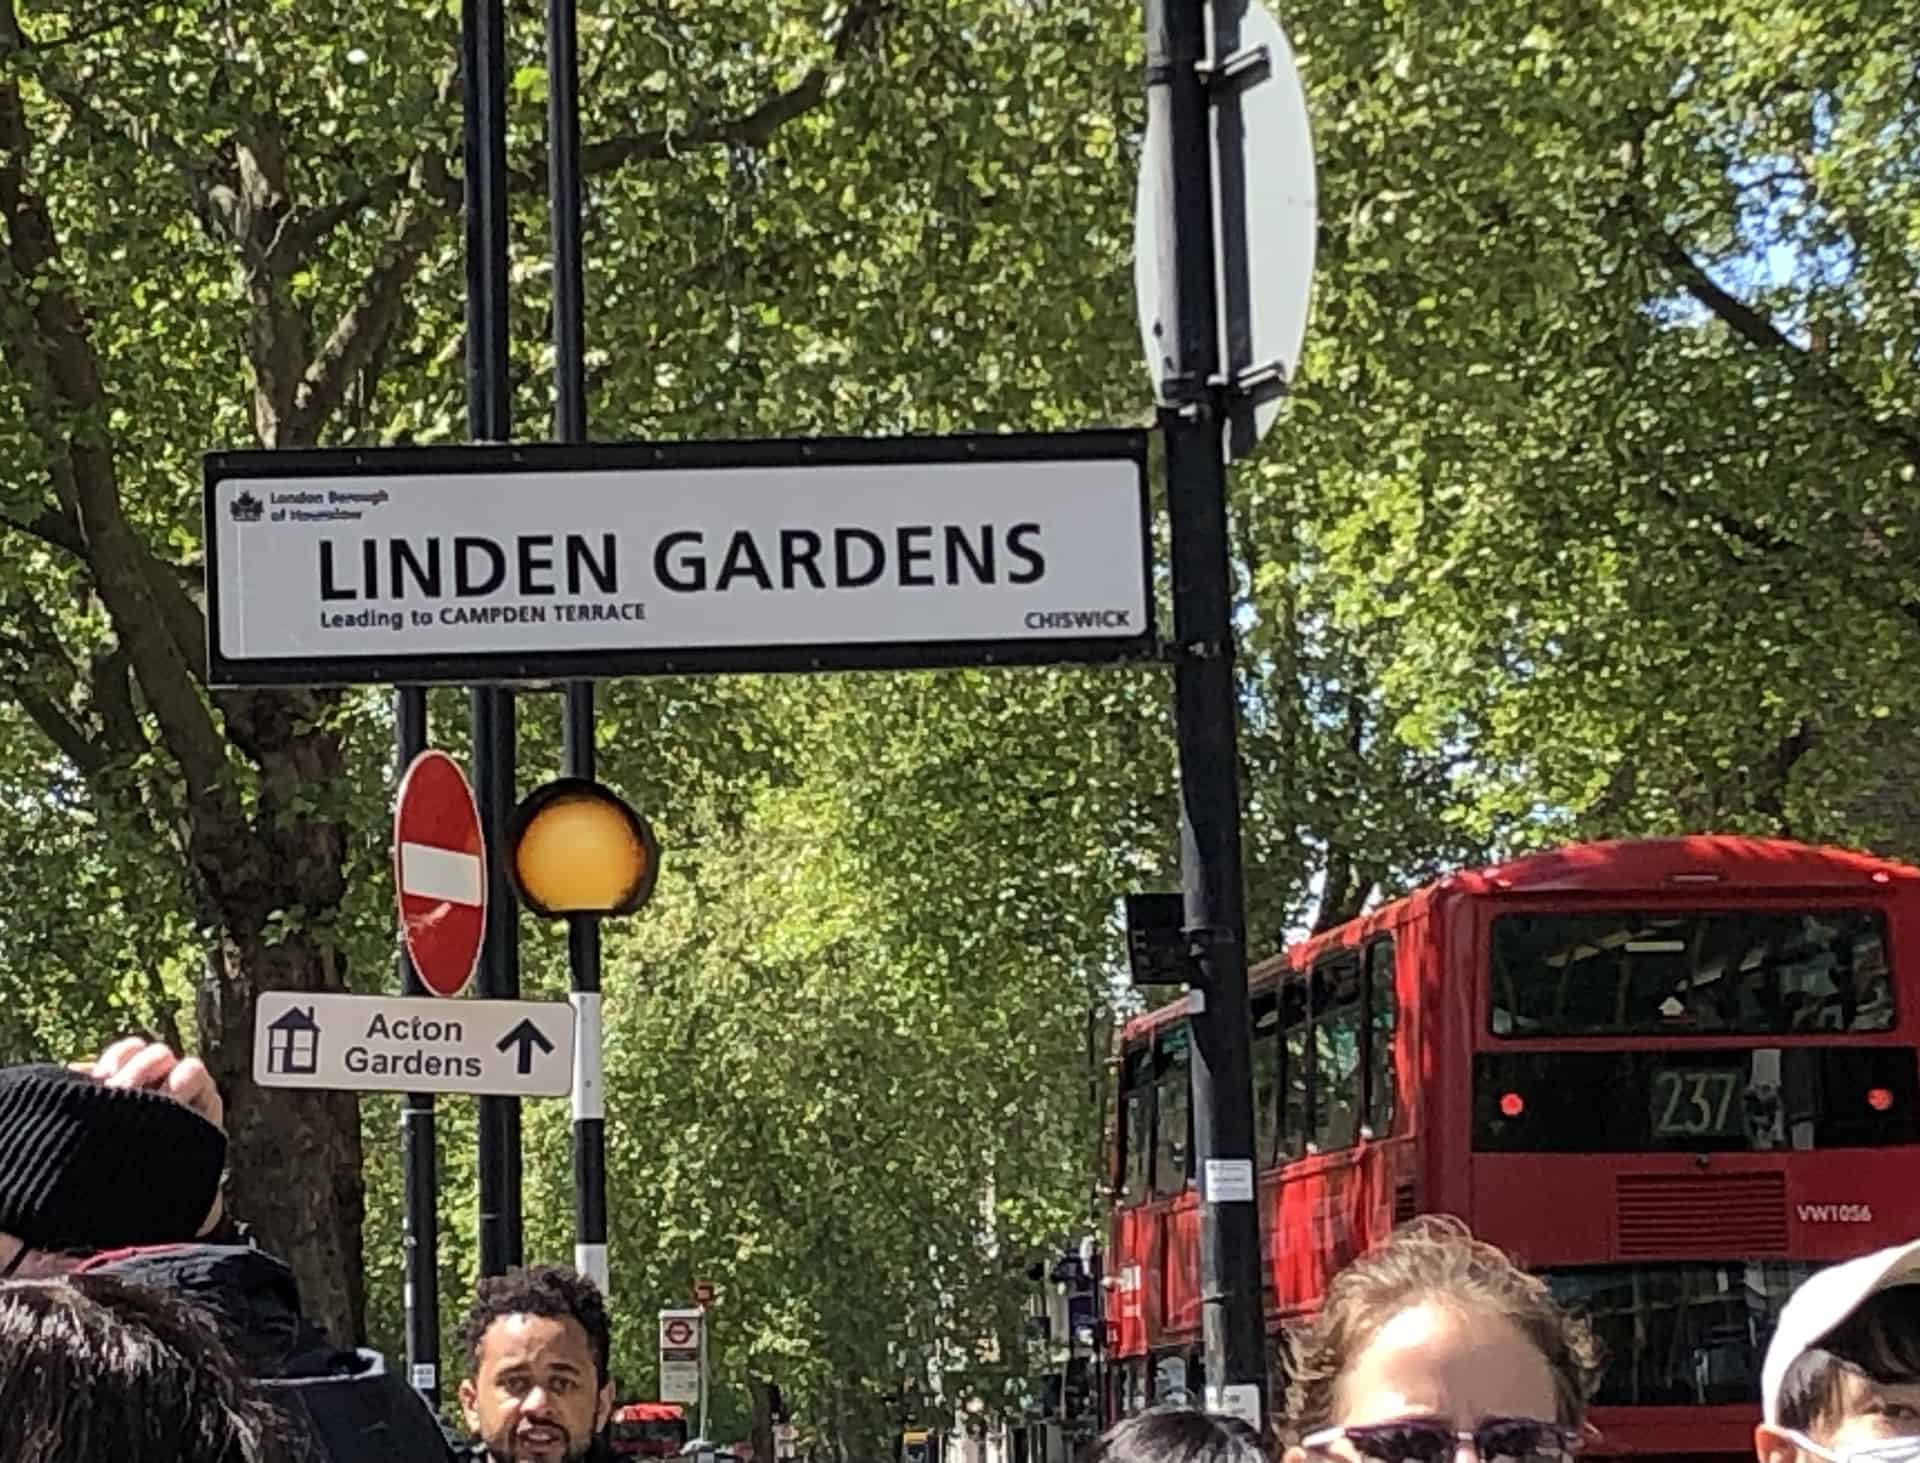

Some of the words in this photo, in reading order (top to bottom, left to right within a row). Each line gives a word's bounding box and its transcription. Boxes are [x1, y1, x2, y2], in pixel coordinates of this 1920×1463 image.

[270, 491, 324, 504] London
[328, 490, 389, 506] Borough
[270, 508, 286, 522] of
[319, 532, 619, 602] LINDEN
[652, 522, 1047, 593] GARDENS
[320, 610, 404, 631] Leading
[411, 608, 433, 627] to
[439, 605, 546, 627] CAMPDEN
[553, 602, 647, 622] TERRACE
[1025, 609, 1131, 630] CHISWICK
[366, 1013, 463, 1042] Acton
[344, 1046, 482, 1078] Gardens
[1655, 1071, 1738, 1133] 237
[1797, 1204, 1872, 1222] VW1056
